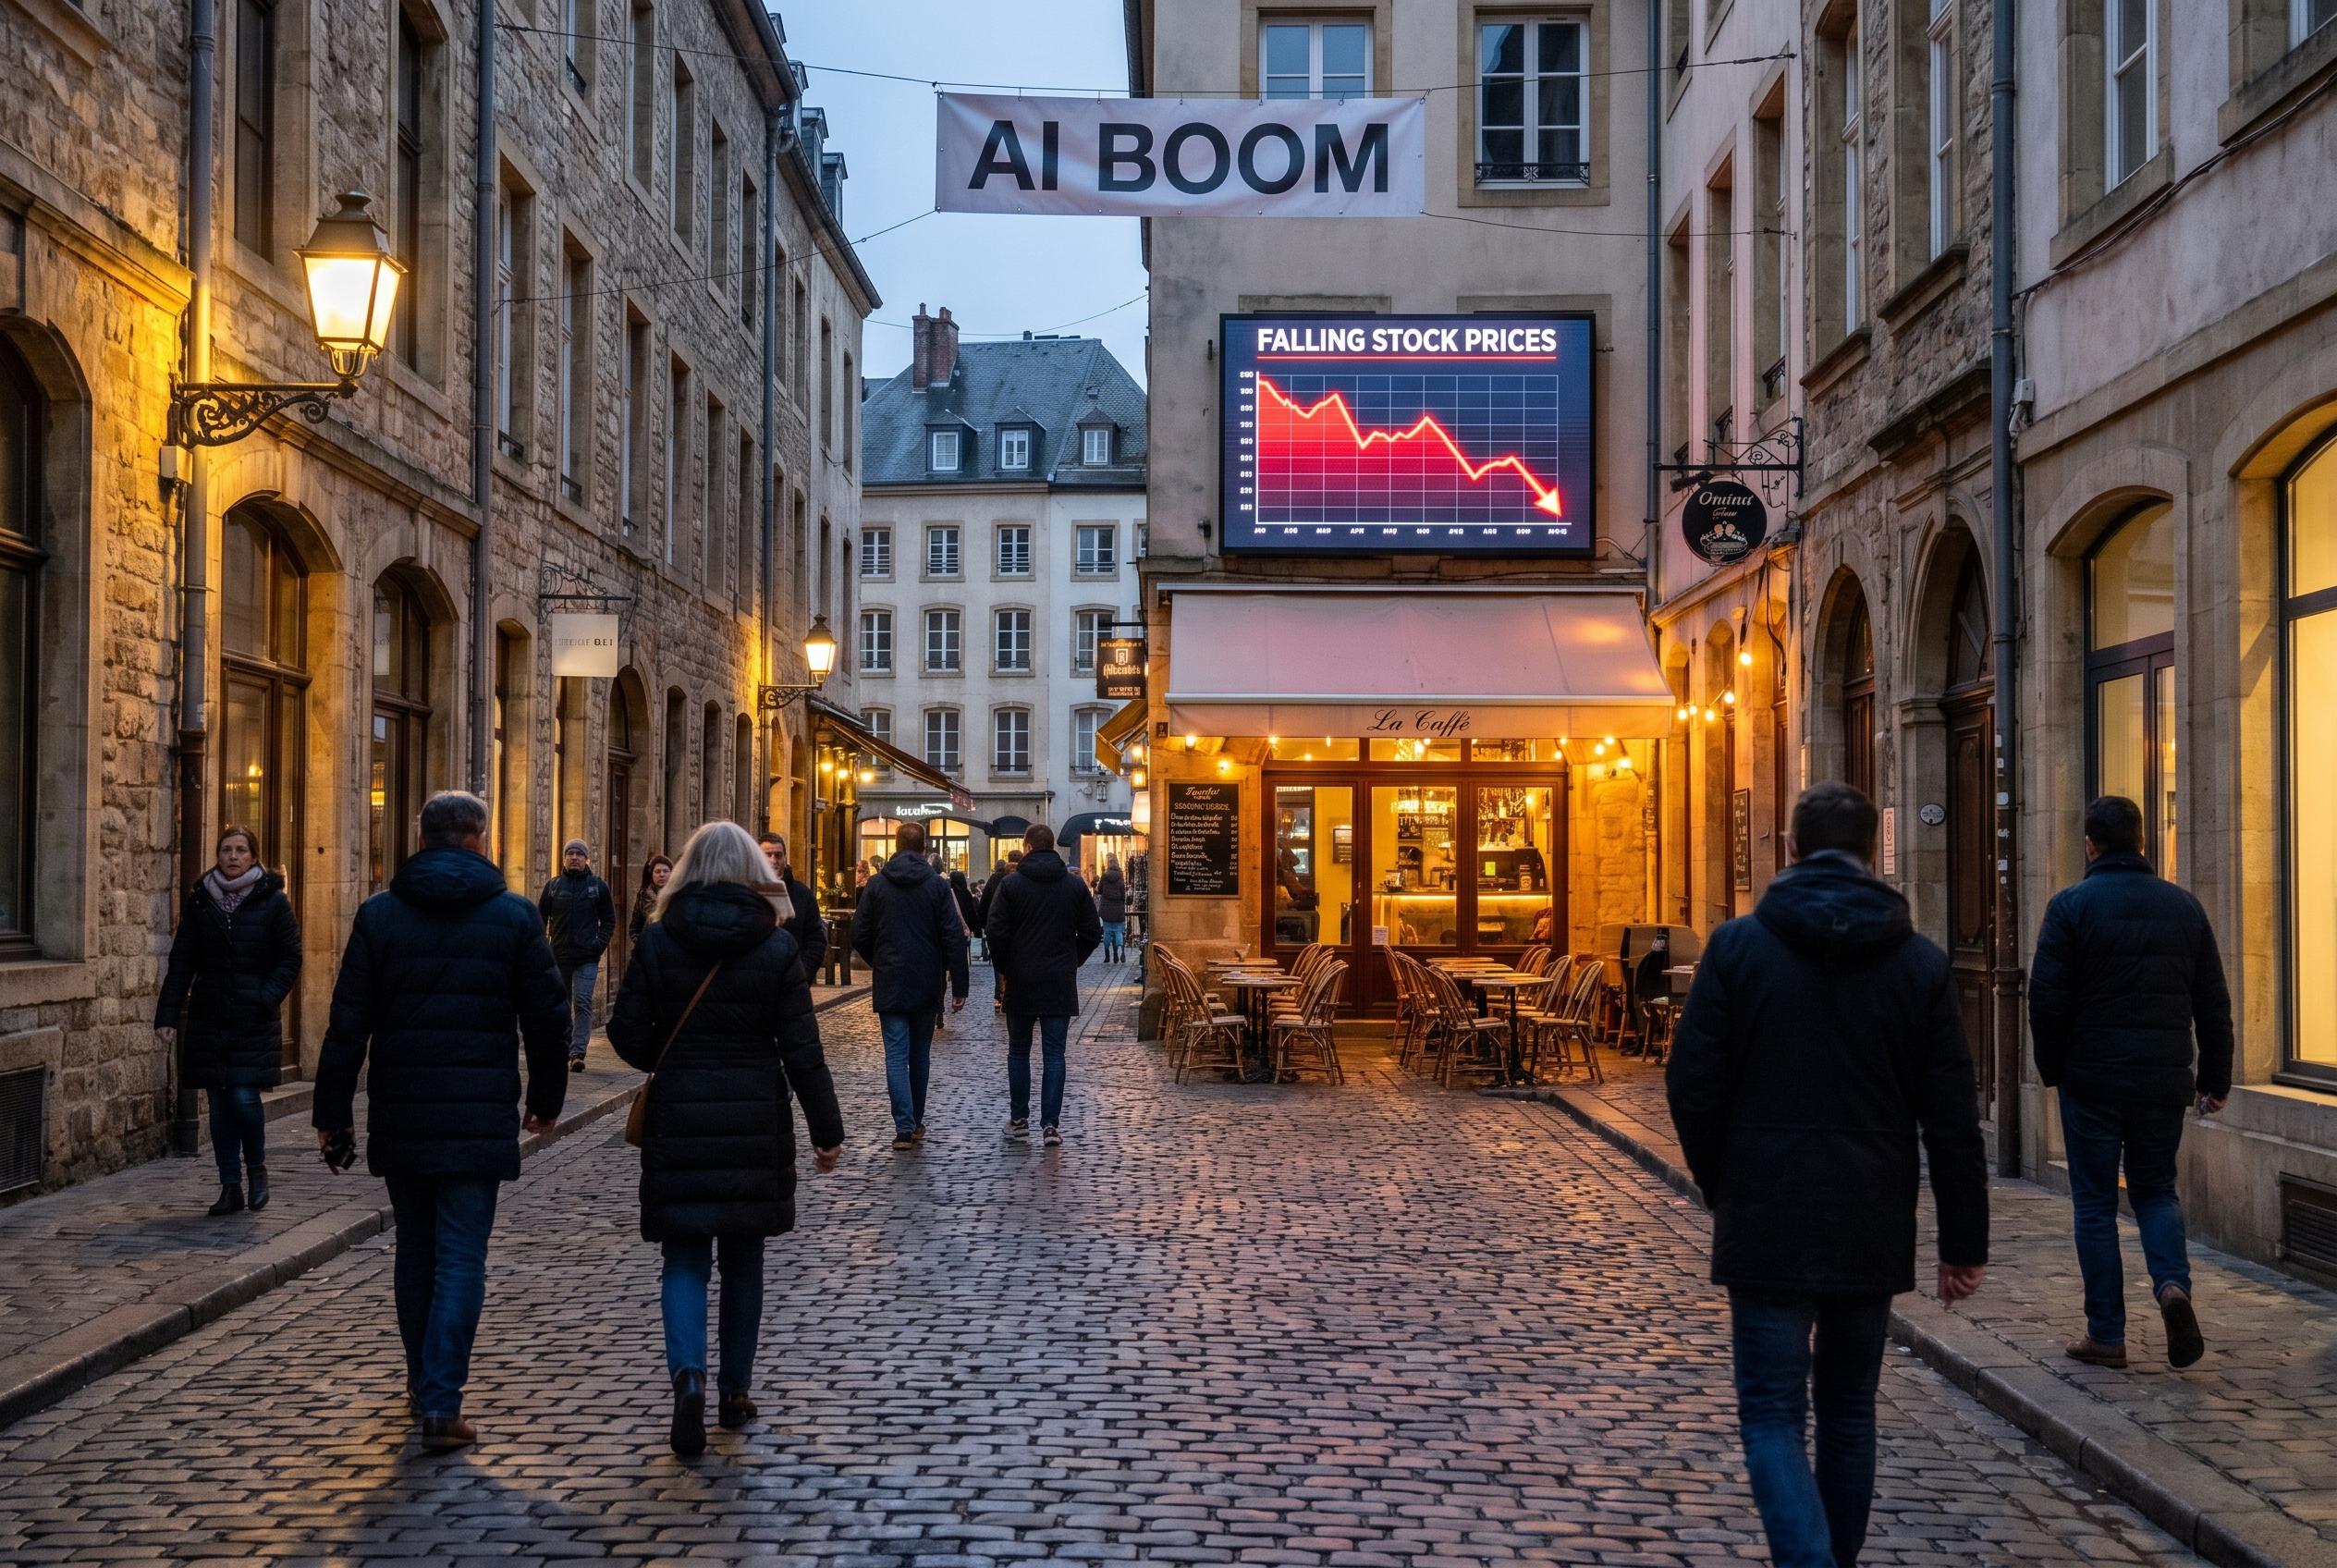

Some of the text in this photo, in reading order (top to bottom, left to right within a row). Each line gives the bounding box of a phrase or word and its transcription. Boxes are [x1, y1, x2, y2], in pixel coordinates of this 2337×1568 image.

[967, 119, 1389, 195] AI BOOM
[1257, 328, 1557, 352] FALLING STOCK PRICES
[1366, 709, 1471, 738] La Caffé
